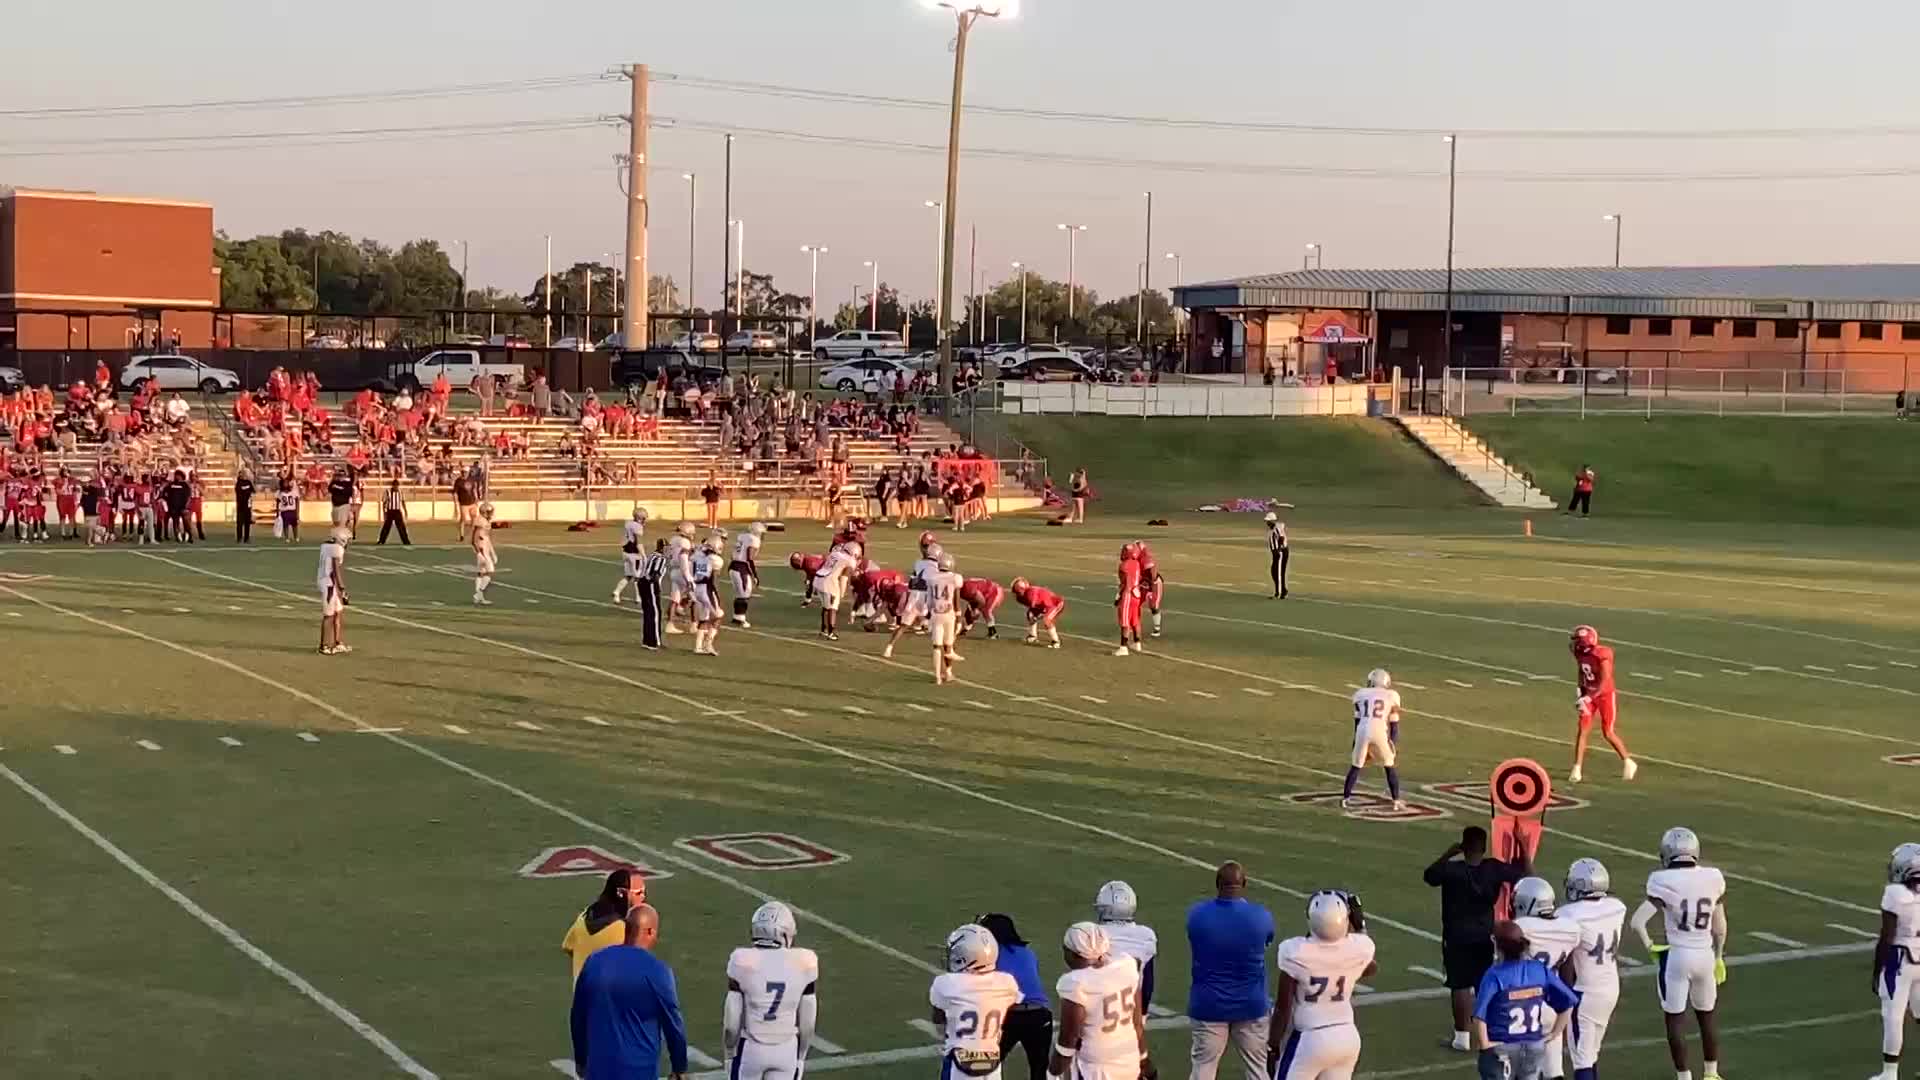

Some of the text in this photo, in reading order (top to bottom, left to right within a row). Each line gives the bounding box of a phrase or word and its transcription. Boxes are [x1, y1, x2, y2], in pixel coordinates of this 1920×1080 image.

[934, 584, 950, 600] 14
[1581, 663, 1596, 681] 8
[1362, 699, 1385, 719] 12
[1676, 897, 1712, 932] 16
[763, 981, 786, 1021] 7
[1304, 975, 1346, 1003] 71
[956, 1009, 1001, 1040] 20
[1101, 986, 1136, 1034] 55
[1508, 1003, 1541, 1034] 21
